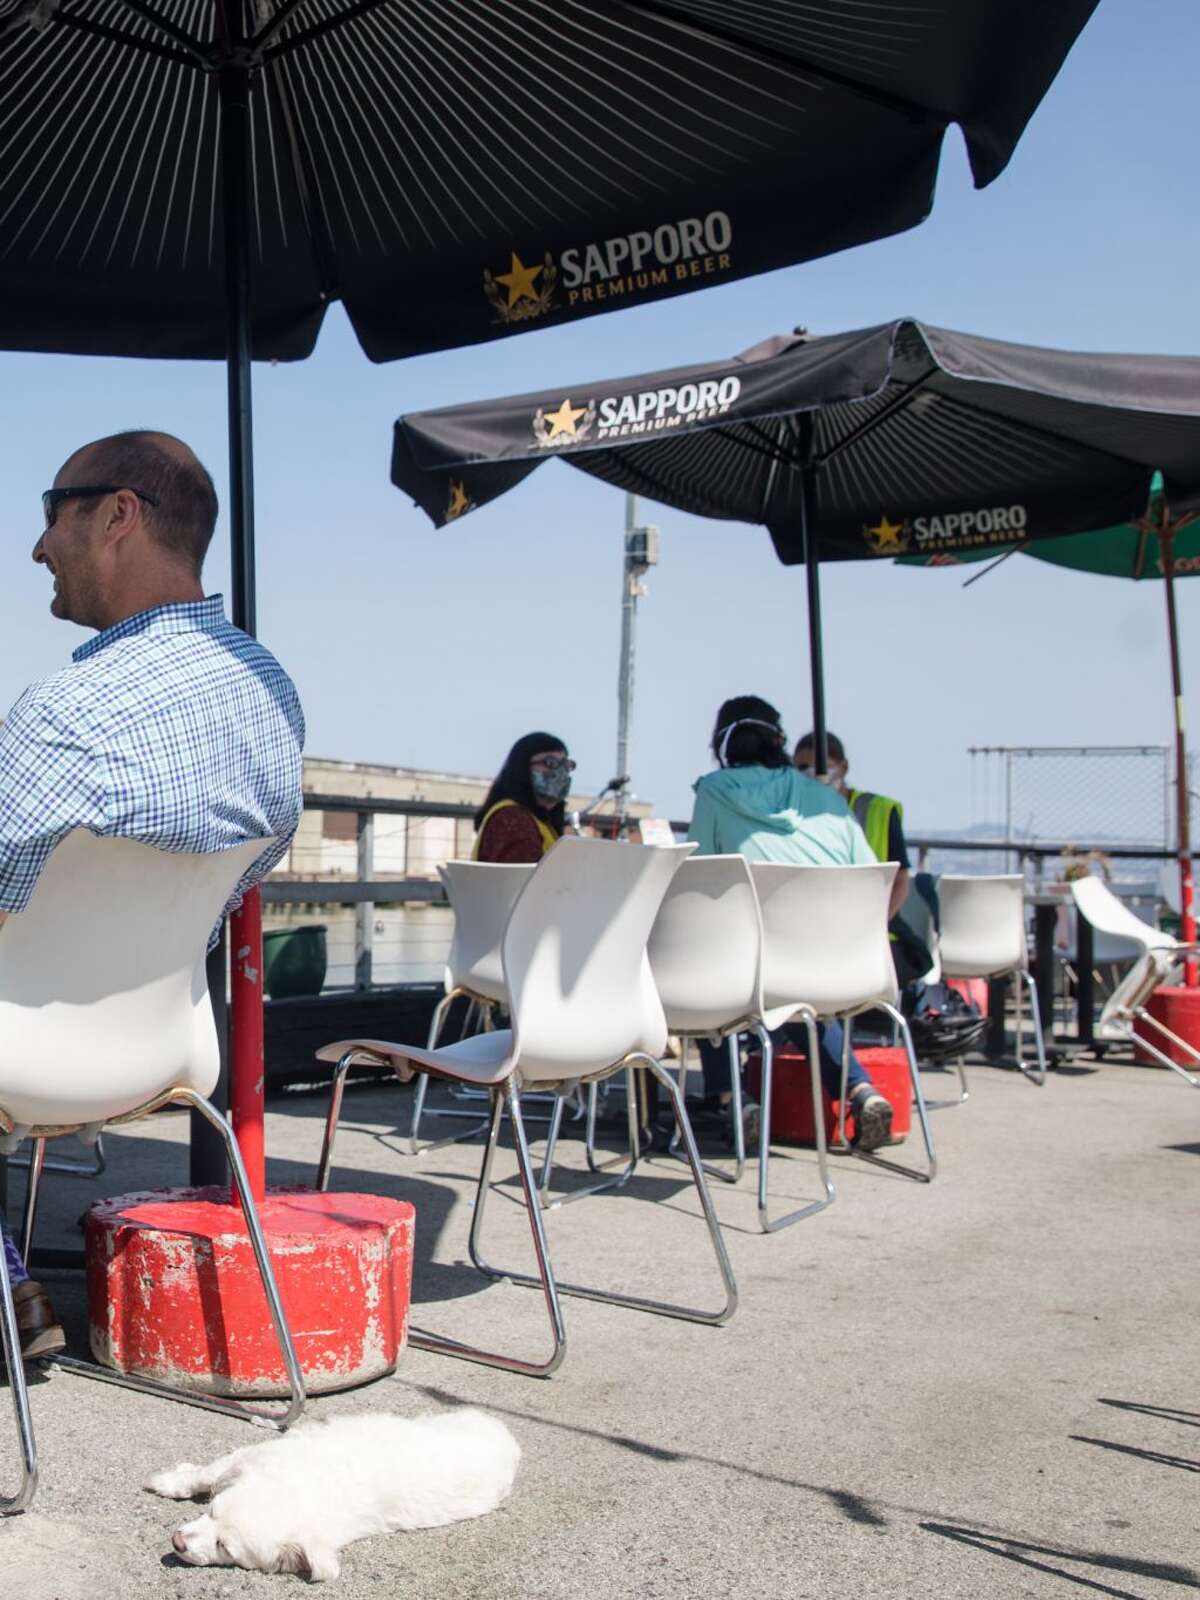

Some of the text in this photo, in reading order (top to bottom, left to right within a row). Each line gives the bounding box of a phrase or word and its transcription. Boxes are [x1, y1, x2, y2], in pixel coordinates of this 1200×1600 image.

[560, 210, 732, 288] SAPPORO
[568, 254, 731, 305] PREMIUM BEER
[597, 375, 741, 428] SAPPORO
[597, 414, 682, 439] PREMIUM
[913, 504, 1027, 540] SAPPORO
[919, 533, 985, 550] PREMIUM
